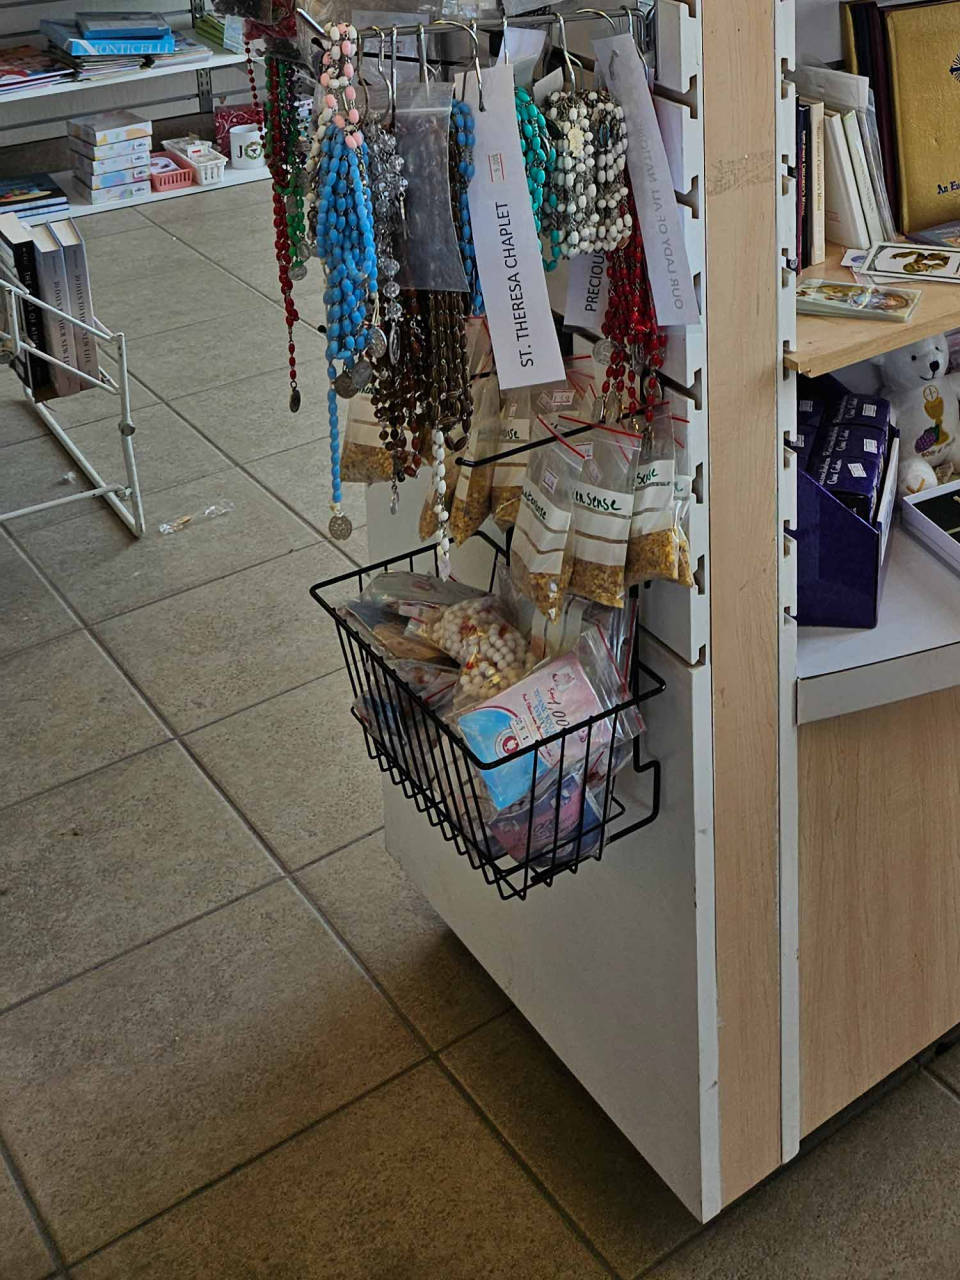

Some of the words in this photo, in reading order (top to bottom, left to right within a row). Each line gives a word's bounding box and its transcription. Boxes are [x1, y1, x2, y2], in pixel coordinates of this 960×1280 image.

[937, 184, 949, 195] An
[495, 201, 518, 269] CHAPLET
[23, 271, 32, 285] THE
[585, 248, 606, 313] PRECIOUS
[507, 271, 530, 342] THERESA
[520, 341, 534, 368] ST.
